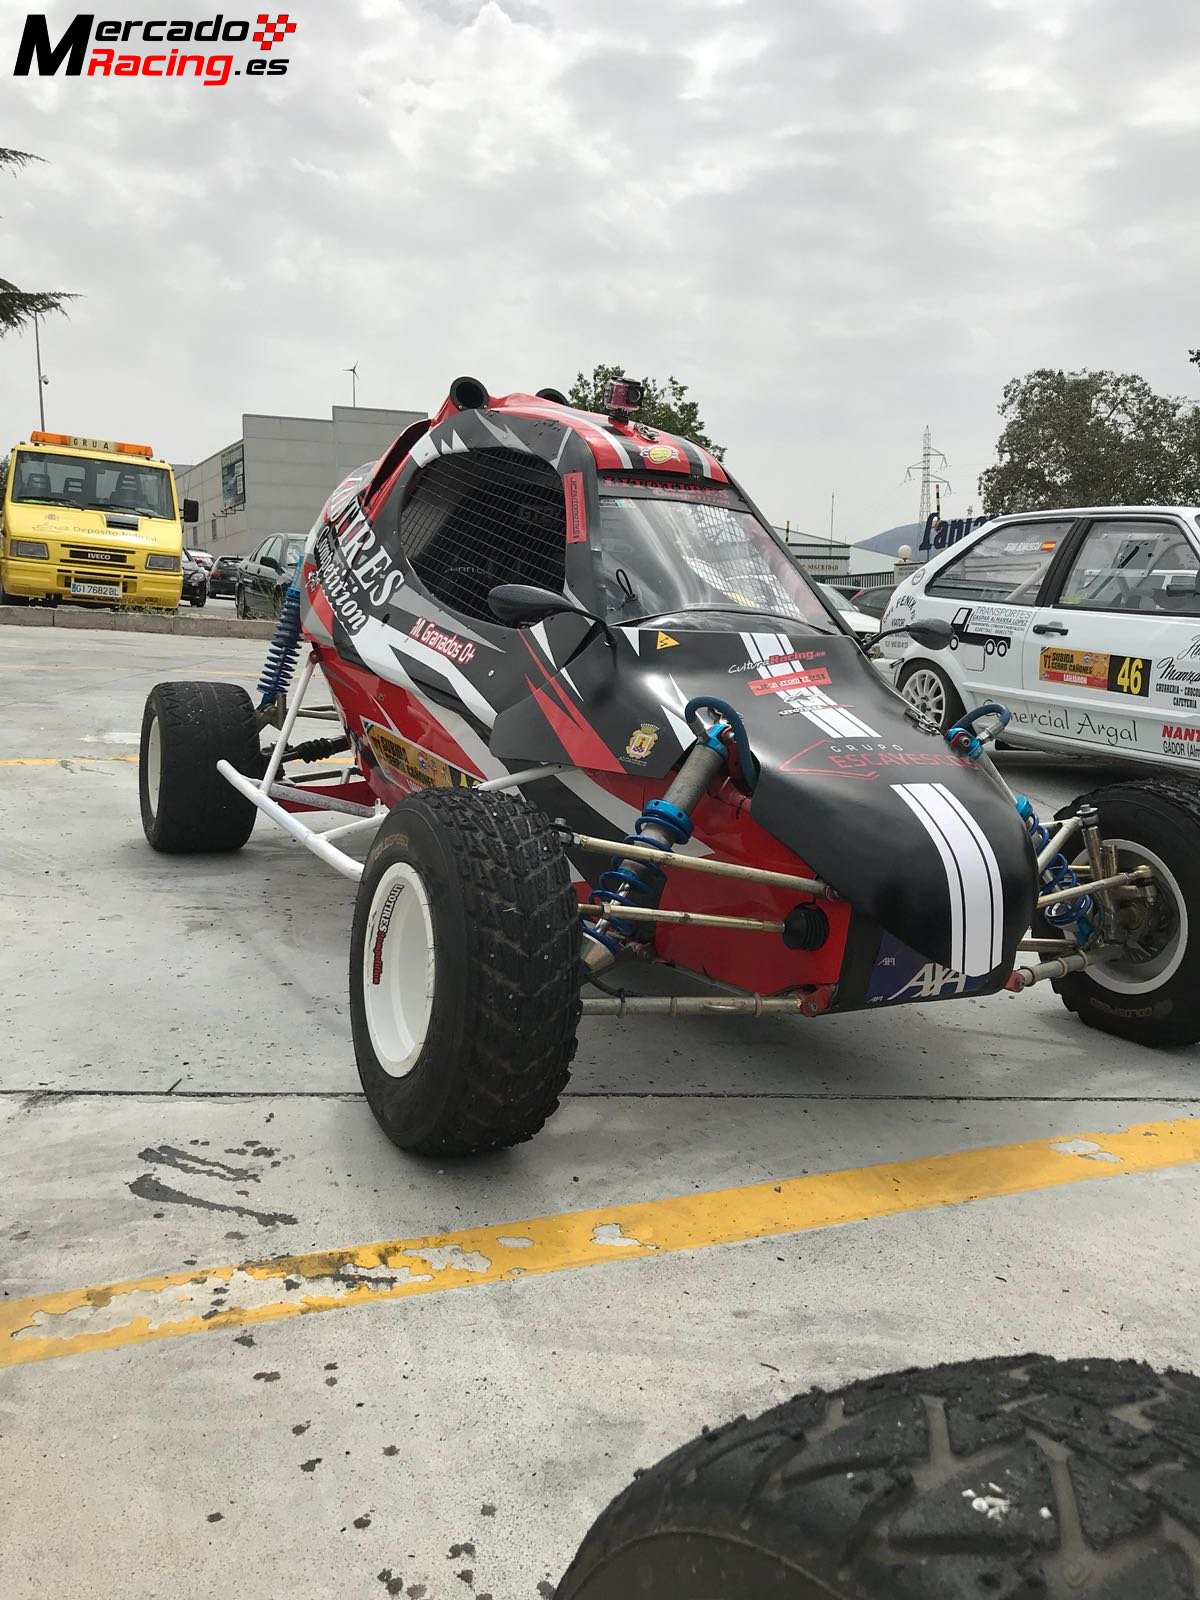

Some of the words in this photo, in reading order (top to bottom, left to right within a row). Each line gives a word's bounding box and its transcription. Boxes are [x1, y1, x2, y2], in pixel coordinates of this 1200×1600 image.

[73, 438, 109, 450] GRUA
[87, 552, 111, 561] IVECO
[975, 605, 1032, 620] TRANSPORTES
[420, 623, 463, 659] Granados
[1052, 652, 1074, 664] SUBIDA
[1051, 661, 1069, 671] CERRO
[1117, 657, 1143, 695] 46
[1155, 682, 1180, 695] CHURRERIA
[1173, 697, 1197, 709] CAFETERIA
[1077, 712, 1138, 746] Argal
[830, 743, 904, 753] GRUPO
[877, 957, 896, 966] AXA
[886, 962, 967, 1001] AXA
